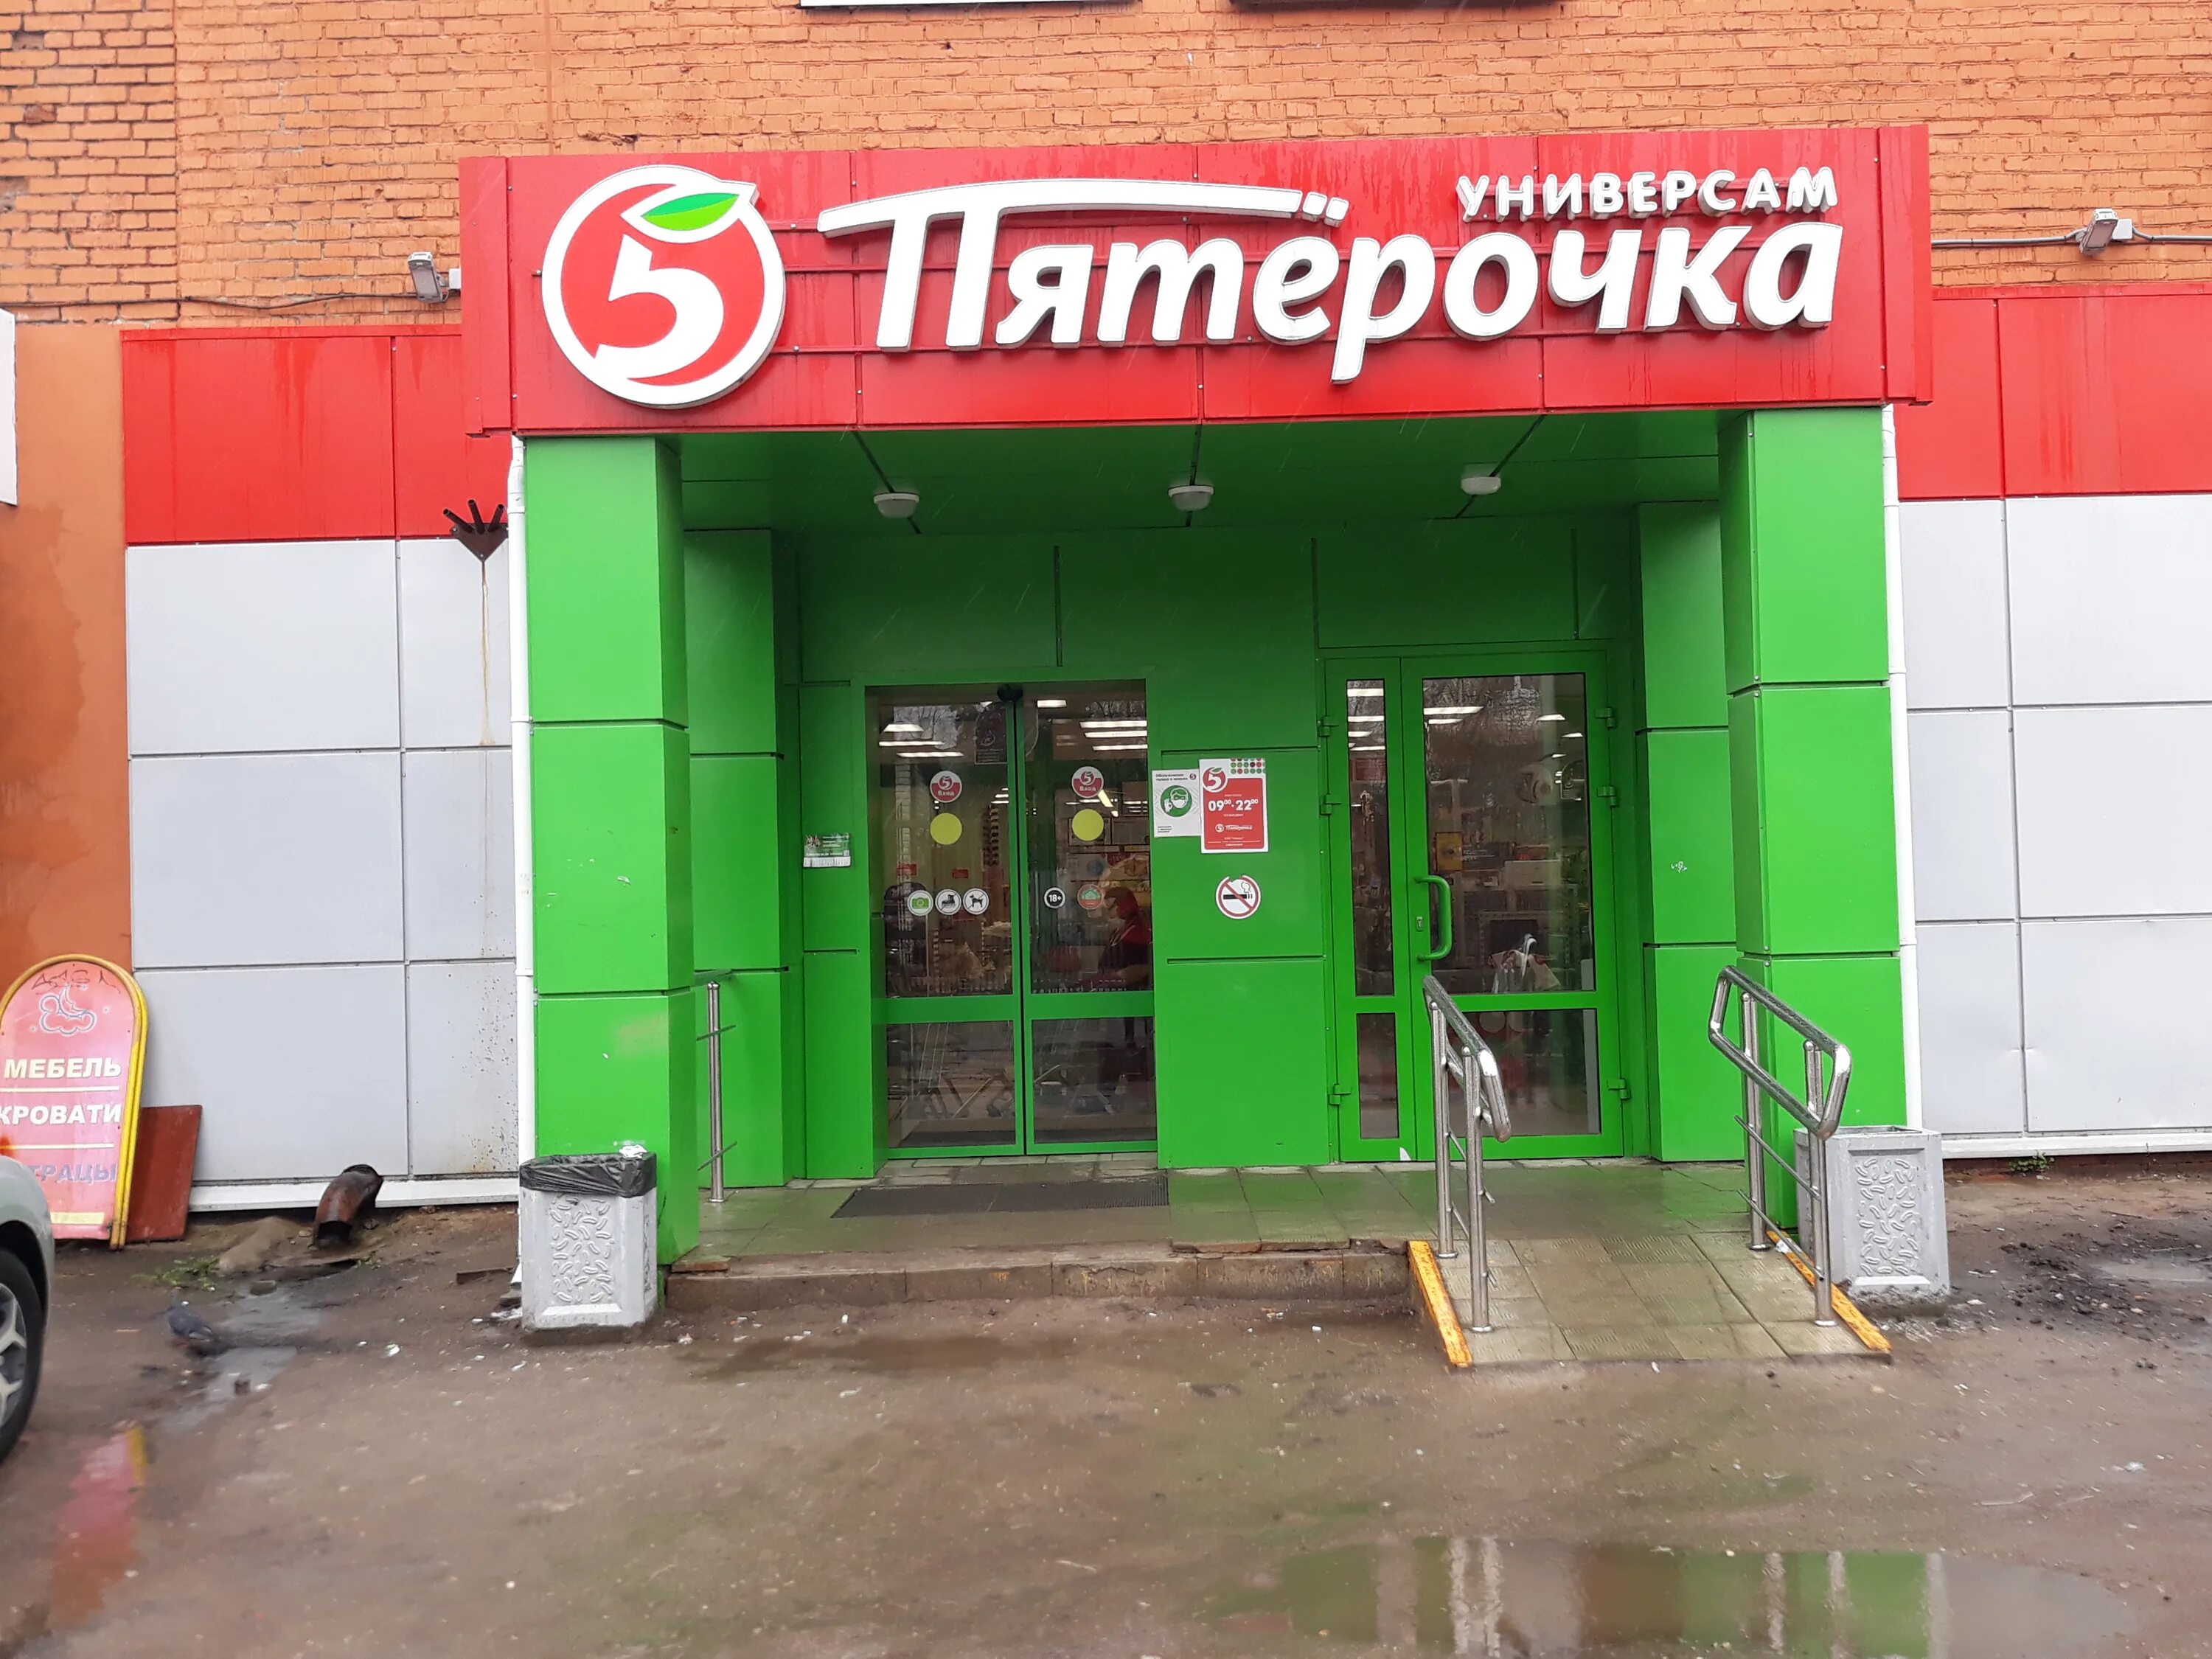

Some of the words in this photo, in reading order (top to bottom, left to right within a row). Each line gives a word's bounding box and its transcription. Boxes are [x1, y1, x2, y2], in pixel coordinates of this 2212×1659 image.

[1455, 166, 1840, 221] УНИВЕРСАМ
[1048, 894, 1062, 902] 18+
[4, 1057, 122, 1079] МЕБЕЛЬ
[28, 1164, 117, 1186] ТРАЦЫ
